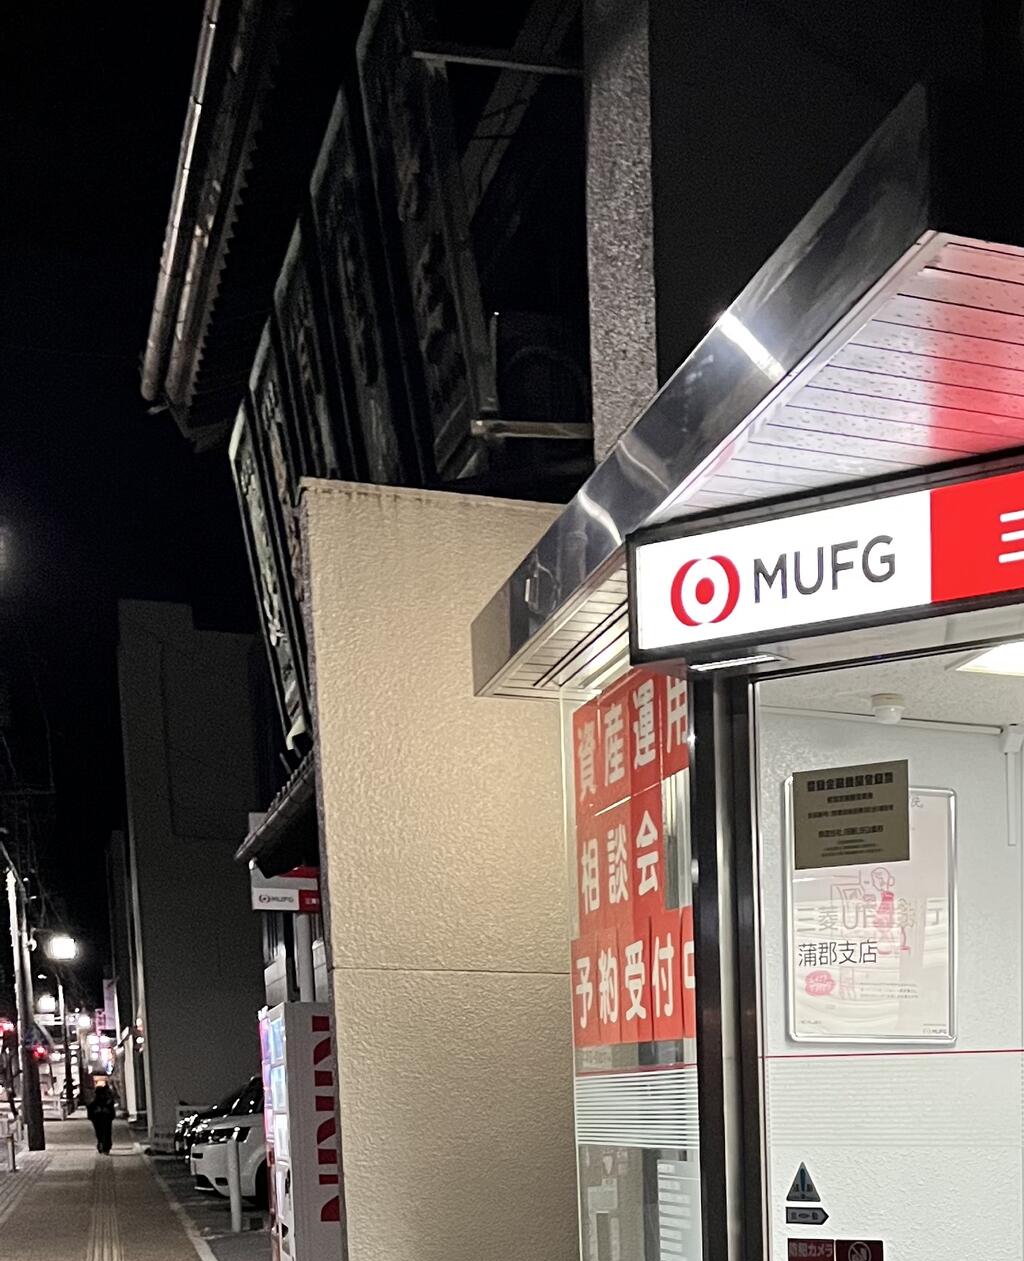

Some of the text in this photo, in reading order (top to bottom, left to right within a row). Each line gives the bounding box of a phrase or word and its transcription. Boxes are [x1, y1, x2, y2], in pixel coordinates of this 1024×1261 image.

[753, 535, 896, 604] MUFG
[577, 676, 688, 798] 資産運用
[581, 809, 658, 915] 相談会
[798, 940, 878, 967] 蒲郡支店
